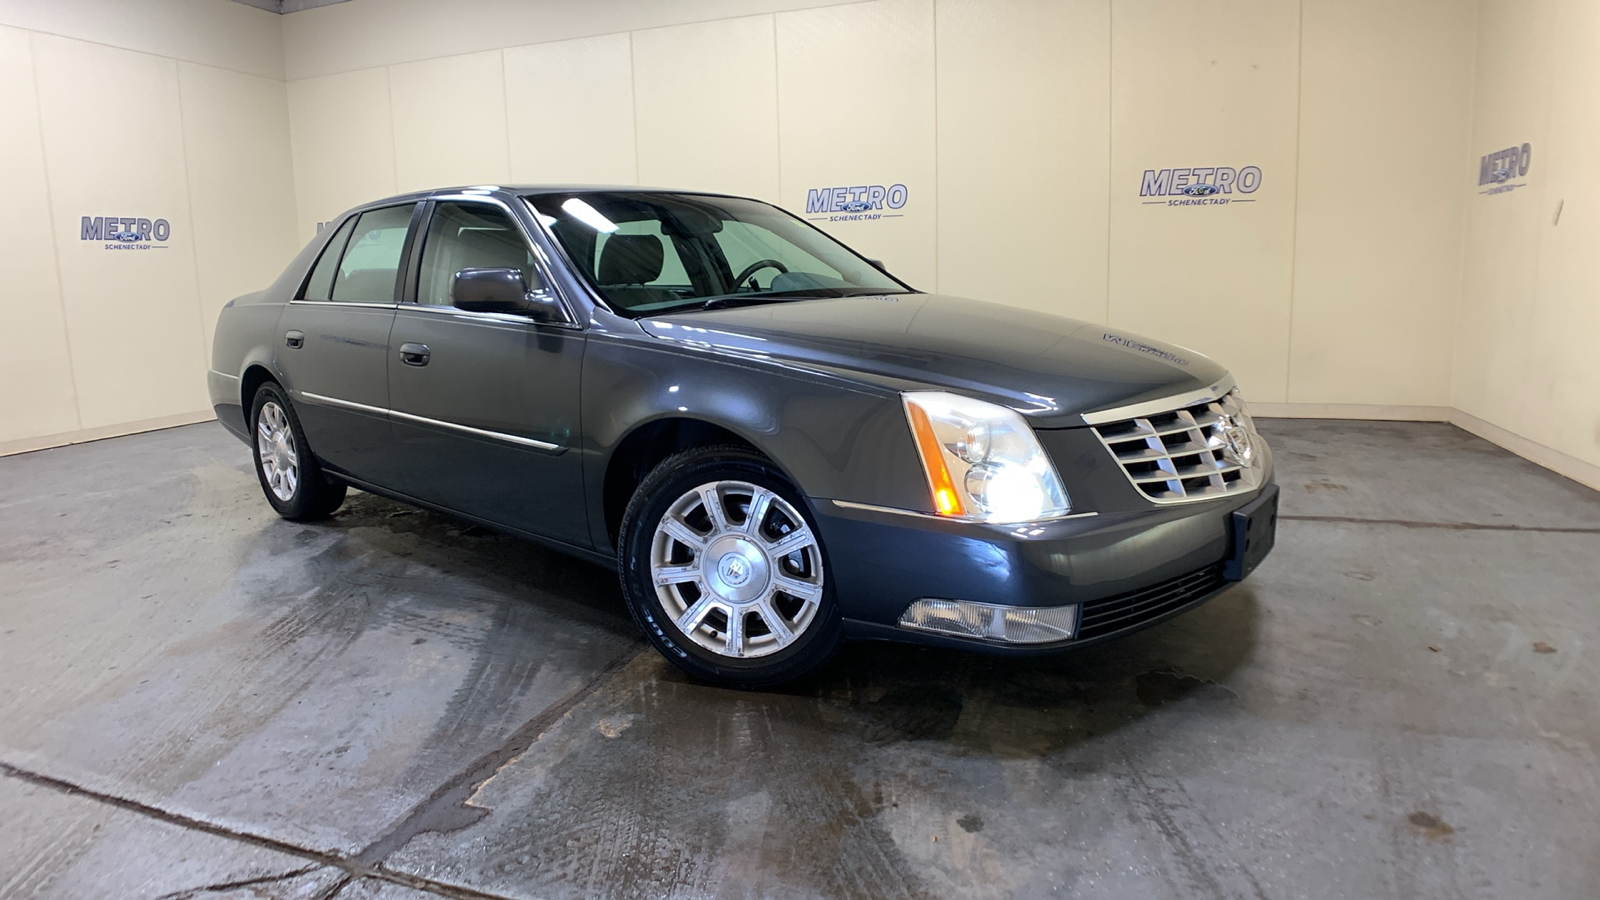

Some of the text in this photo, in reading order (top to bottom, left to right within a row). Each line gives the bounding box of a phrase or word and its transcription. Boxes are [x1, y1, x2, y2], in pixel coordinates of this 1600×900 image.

[1479, 142, 1531, 186] METRO
[1139, 165, 1262, 197] METRO
[805, 183, 908, 213] METRO
[1167, 198, 1231, 206] SCHENECTADY
[80, 216, 170, 241] METRO
[829, 213, 882, 222] SCHENECTADY
